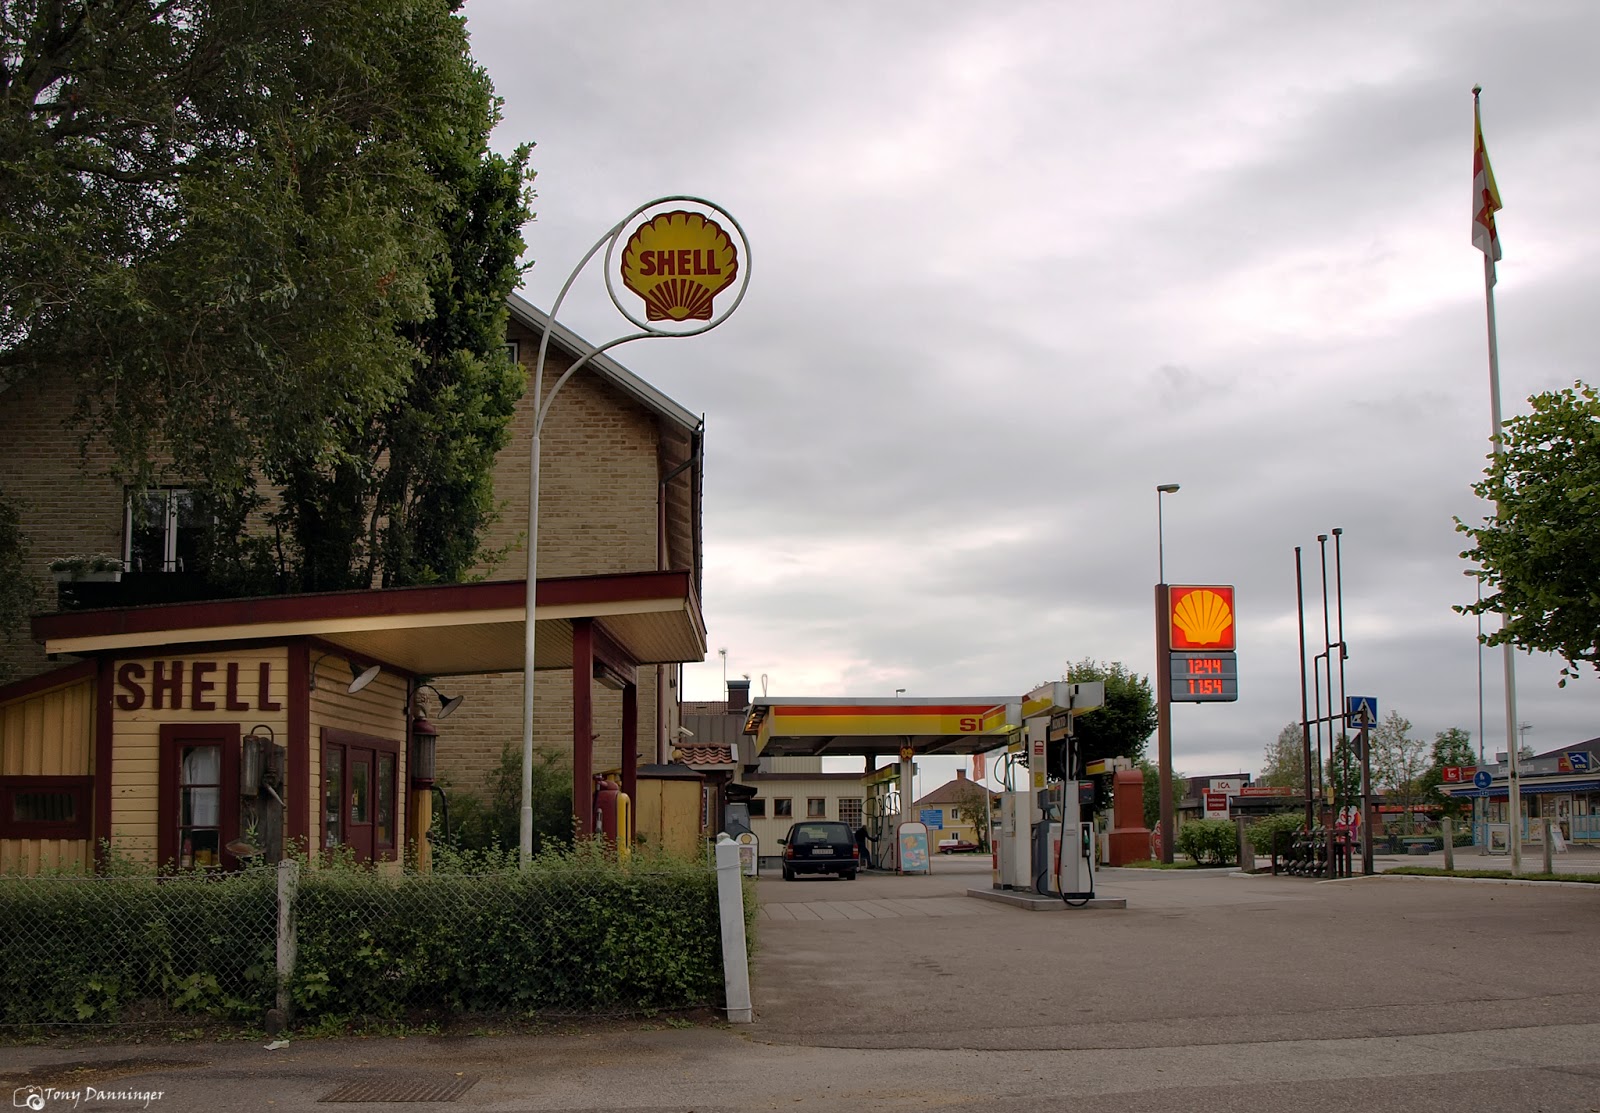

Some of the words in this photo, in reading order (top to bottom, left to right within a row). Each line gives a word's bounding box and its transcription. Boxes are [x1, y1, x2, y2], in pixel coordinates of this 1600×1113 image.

[639, 249, 722, 276] SHELL
[116, 661, 282, 711] SHELL
[959, 718, 983, 732] S
